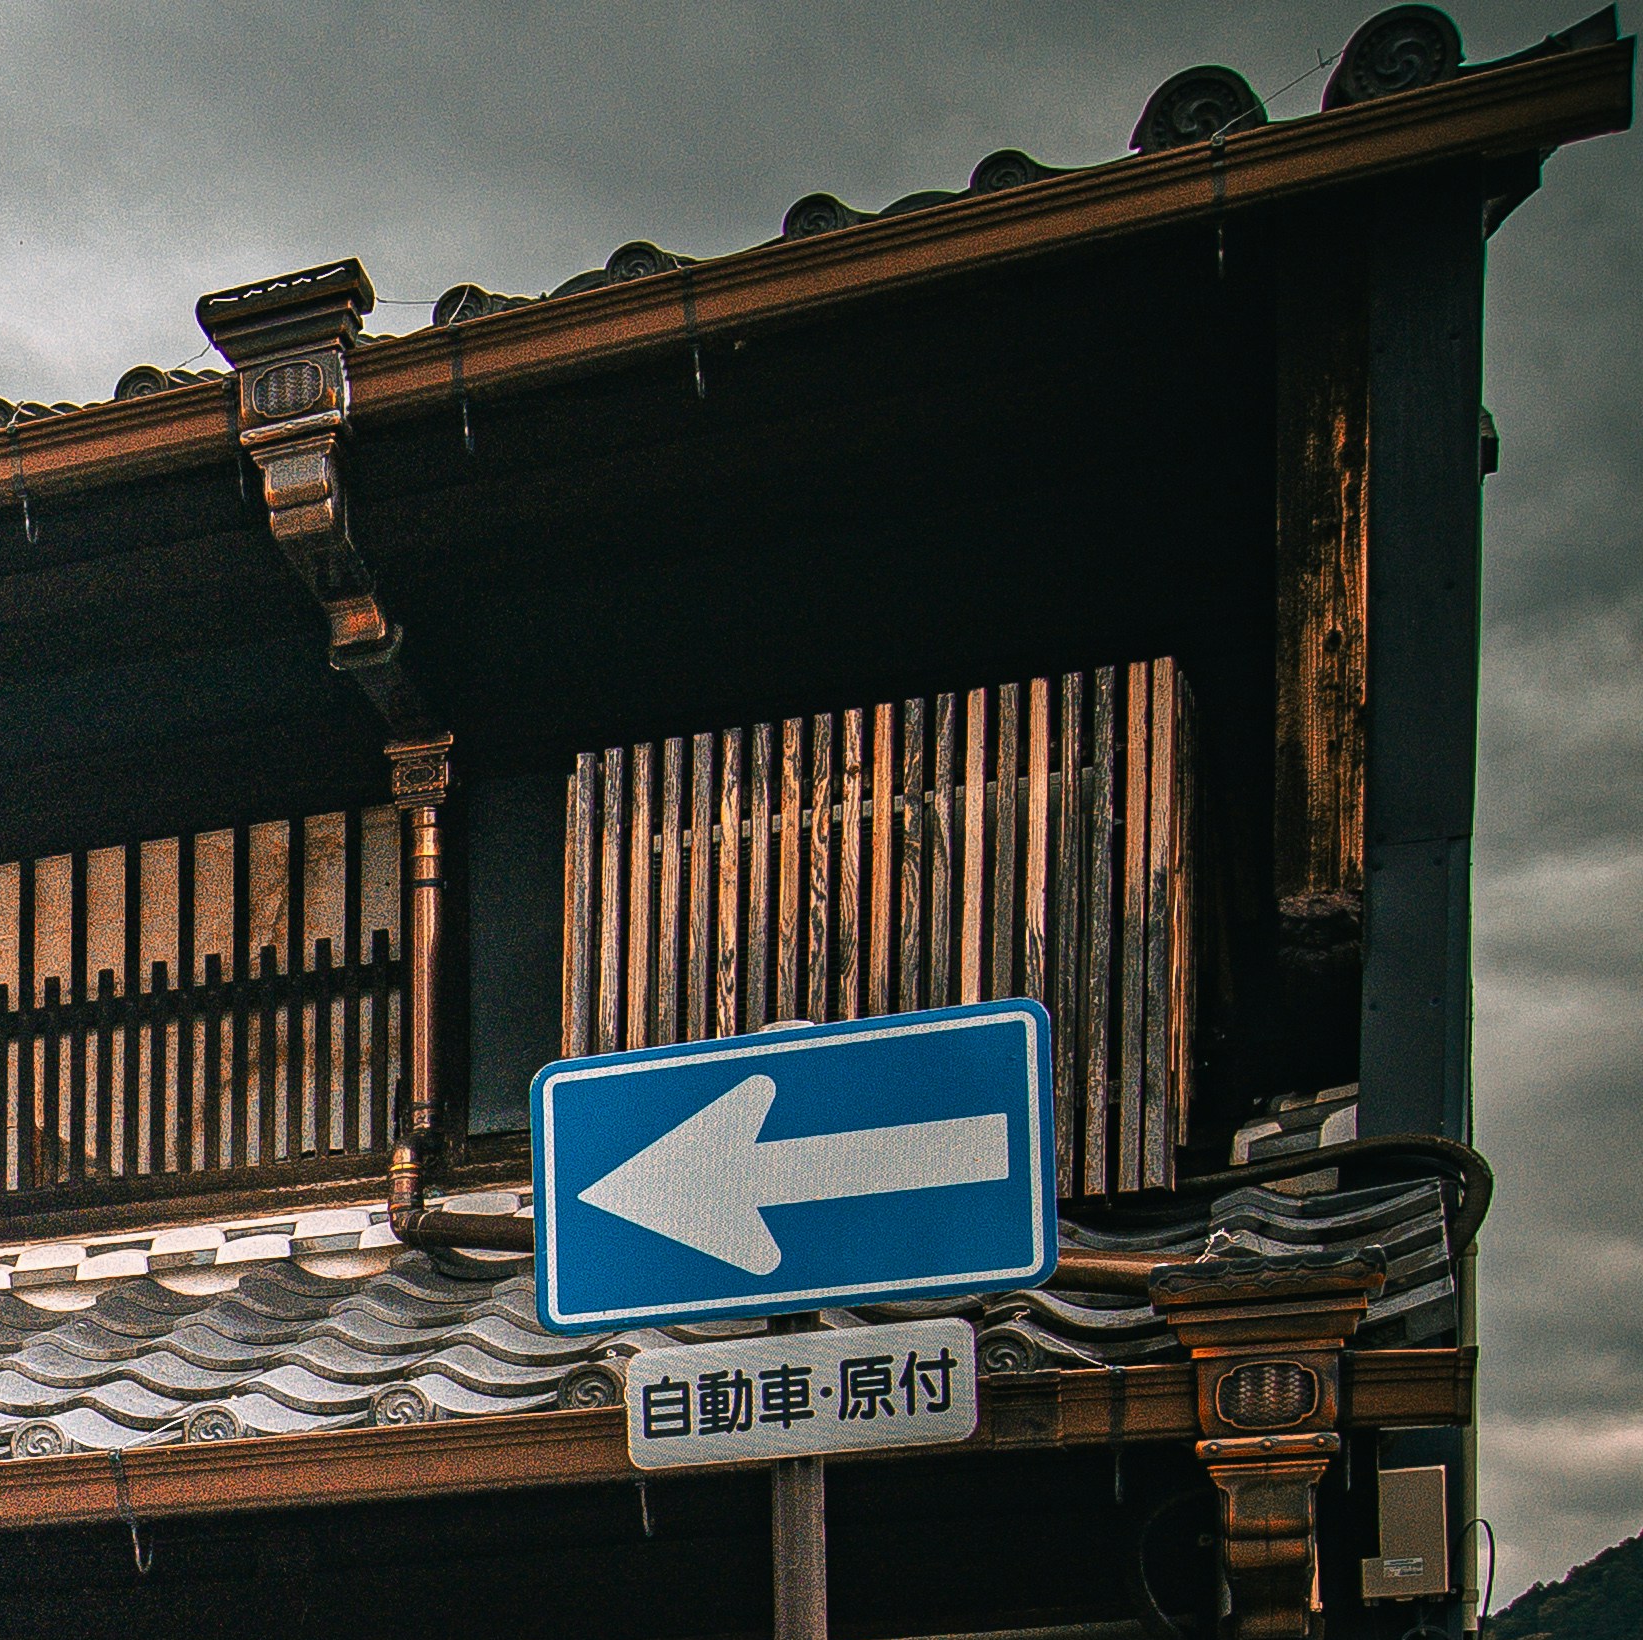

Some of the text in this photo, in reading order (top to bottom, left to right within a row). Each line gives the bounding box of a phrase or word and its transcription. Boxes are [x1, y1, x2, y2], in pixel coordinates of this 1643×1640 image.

[642, 1346, 959, 1440] 自動車・原付
